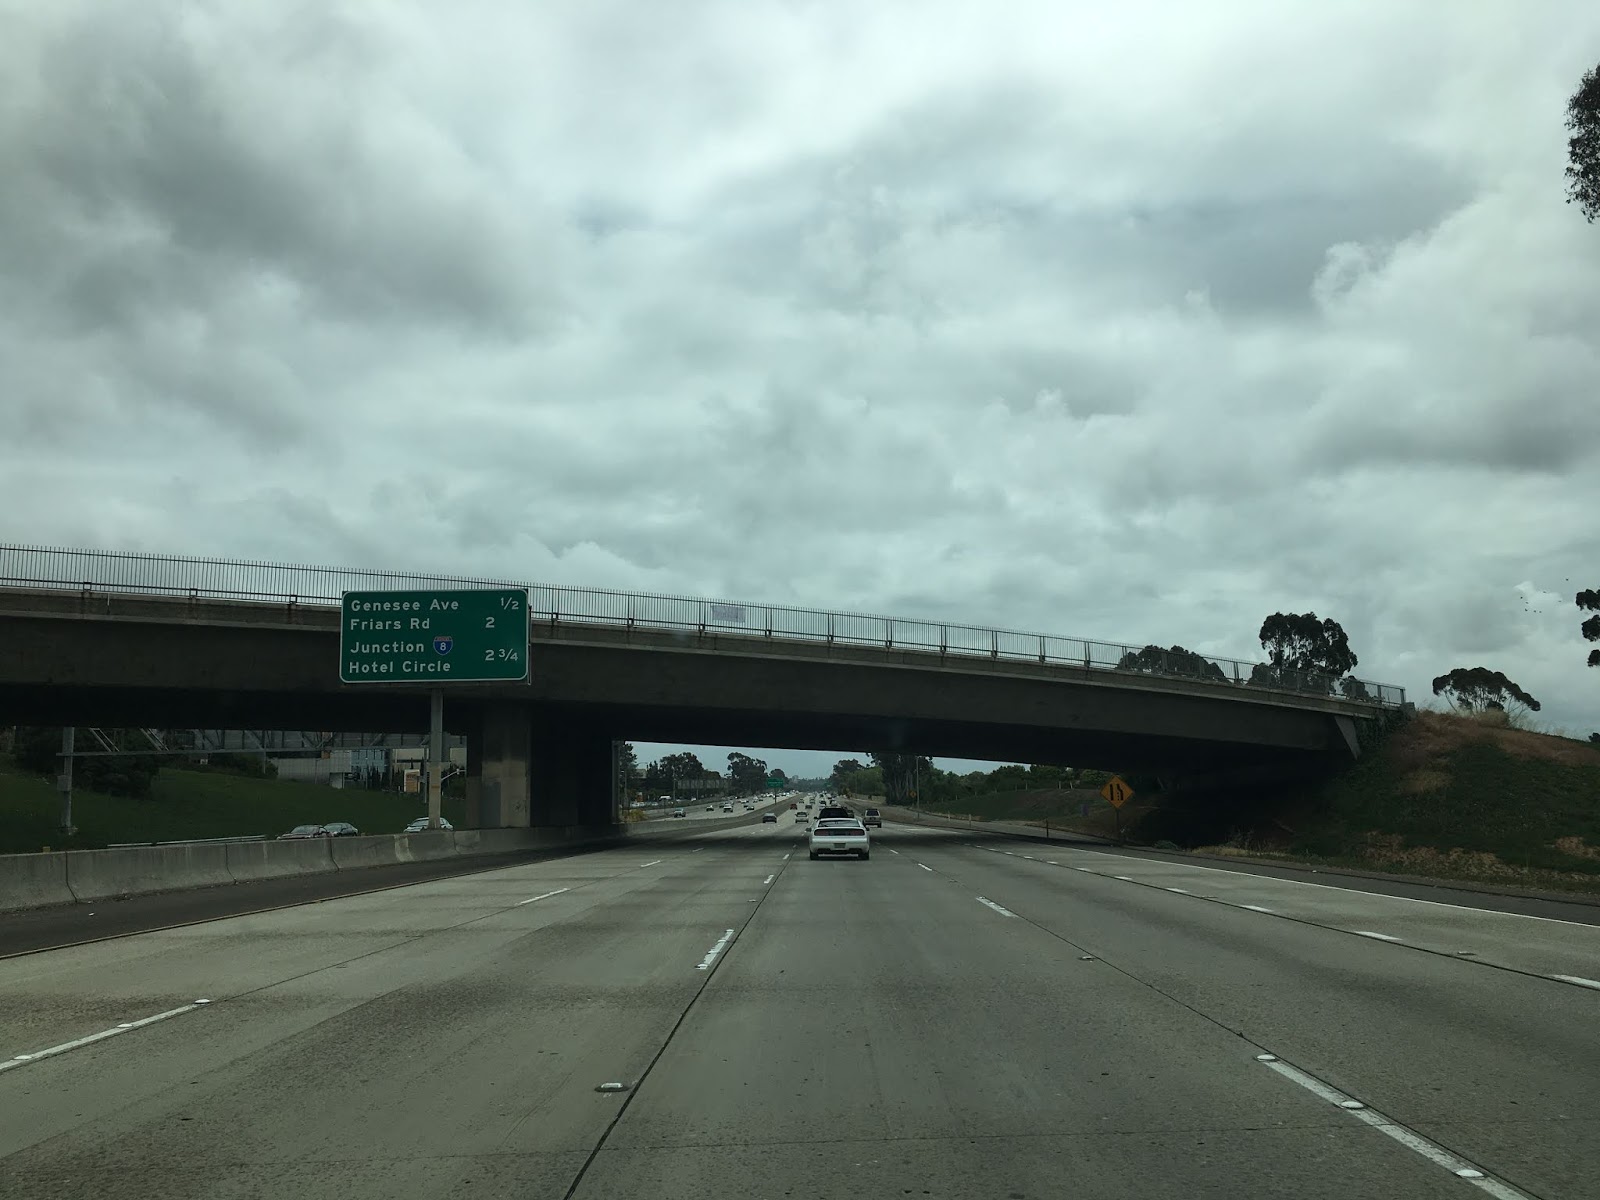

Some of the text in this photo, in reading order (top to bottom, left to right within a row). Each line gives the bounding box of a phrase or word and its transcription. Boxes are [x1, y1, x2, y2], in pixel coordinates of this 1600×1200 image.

[351, 598, 459, 611] Genesee Ave
[500, 597, 519, 610] 1/2
[350, 618, 430, 630] Friars Rd
[485, 617, 495, 628] 2
[350, 641, 447, 653] Junction 8
[349, 660, 451, 673] Hotel Circle
